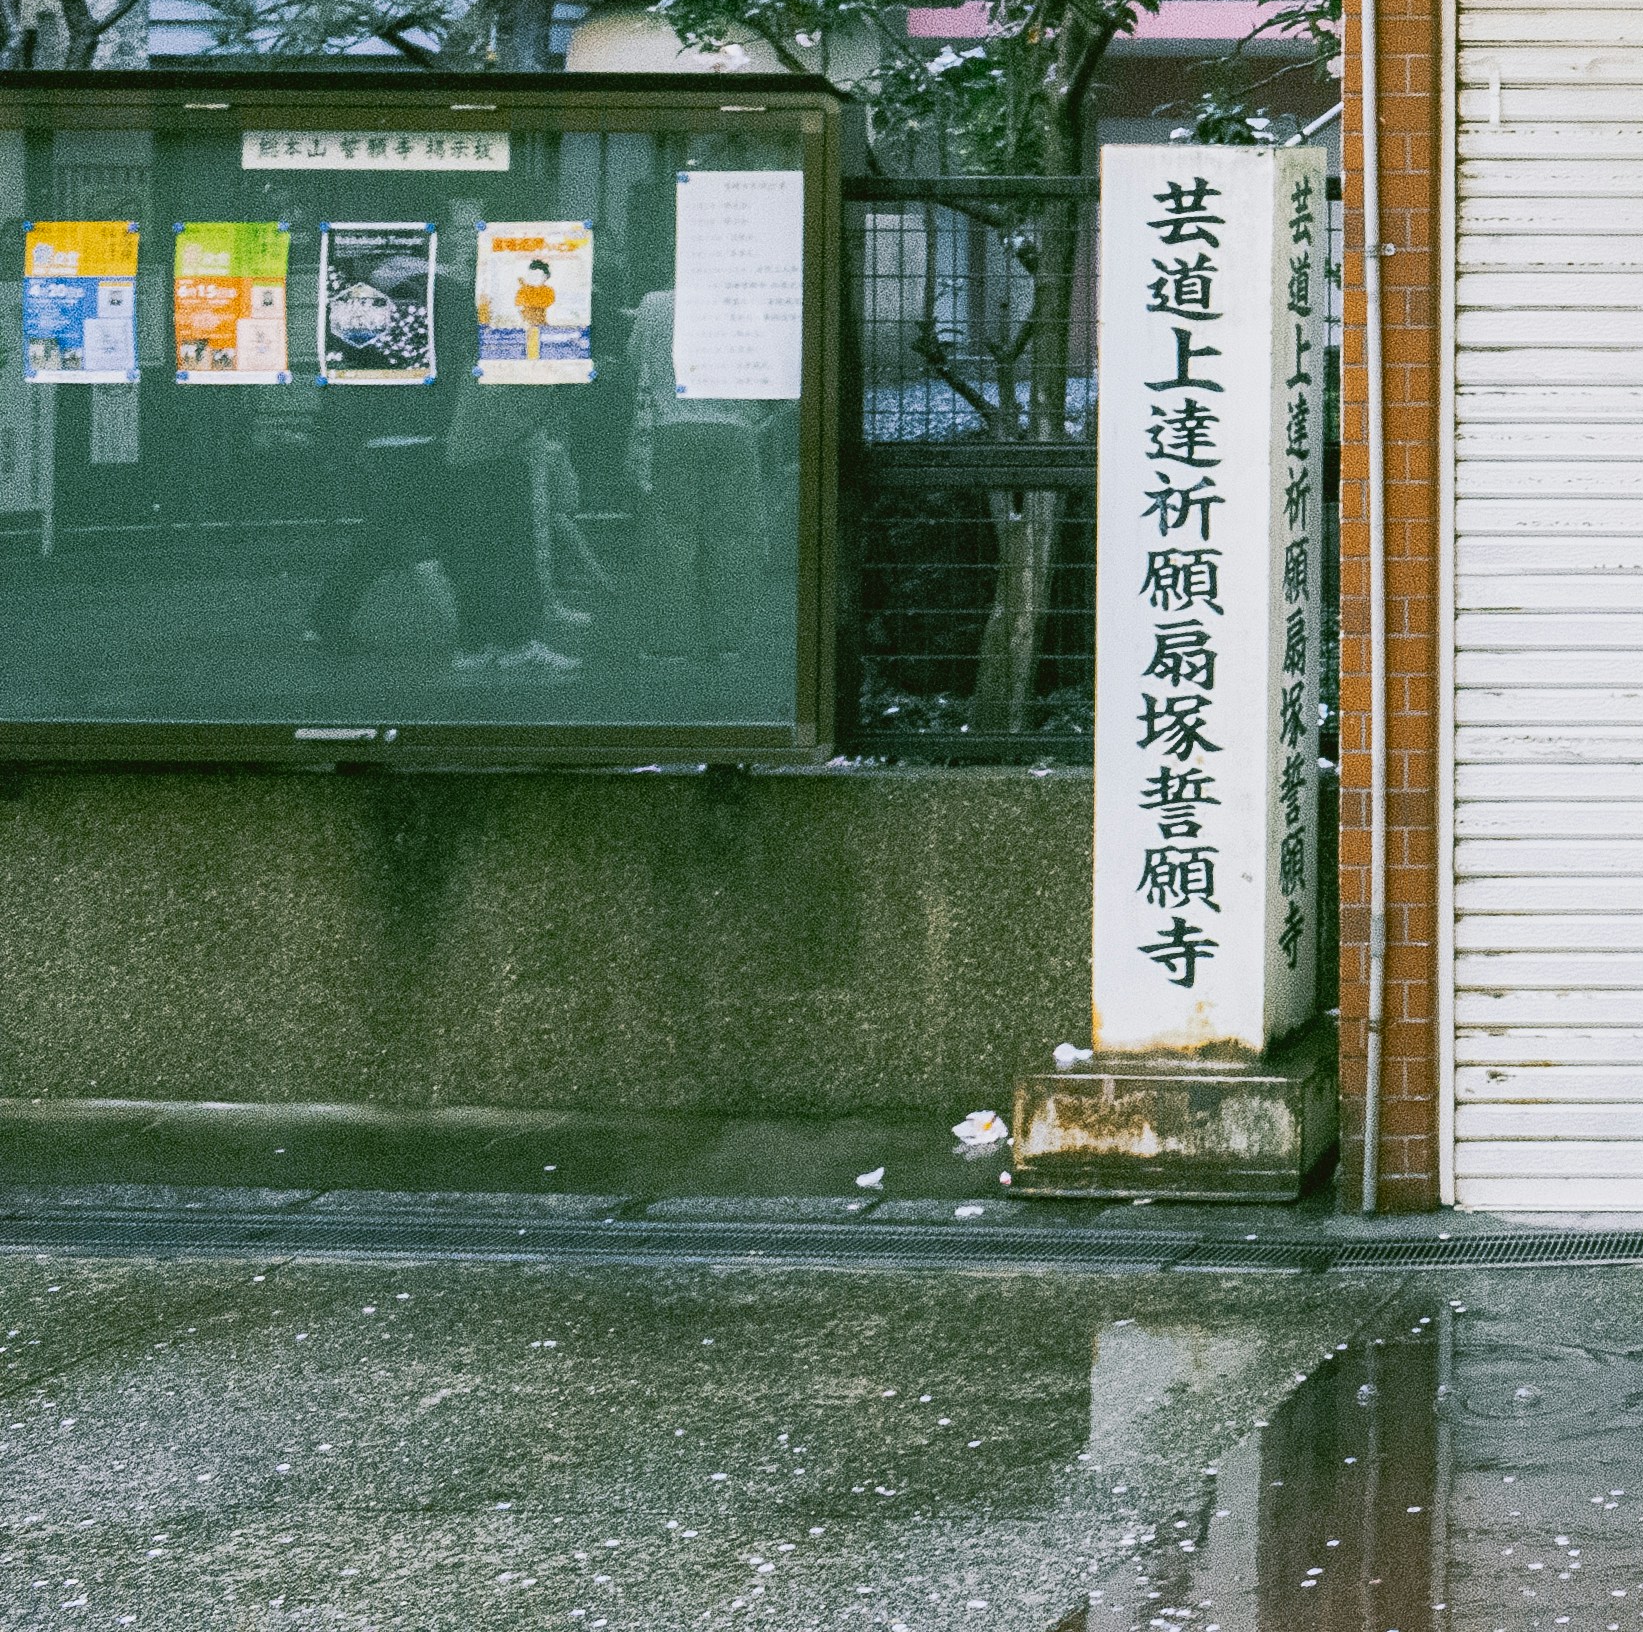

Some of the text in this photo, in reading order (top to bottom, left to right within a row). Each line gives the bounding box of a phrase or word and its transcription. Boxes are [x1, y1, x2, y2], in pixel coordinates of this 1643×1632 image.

[1136, 176, 1227, 989] 芸道上達祈願扇塚誓願寺
[1277, 174, 1315, 969] 芸道上達祈願扇塚誓願寺
